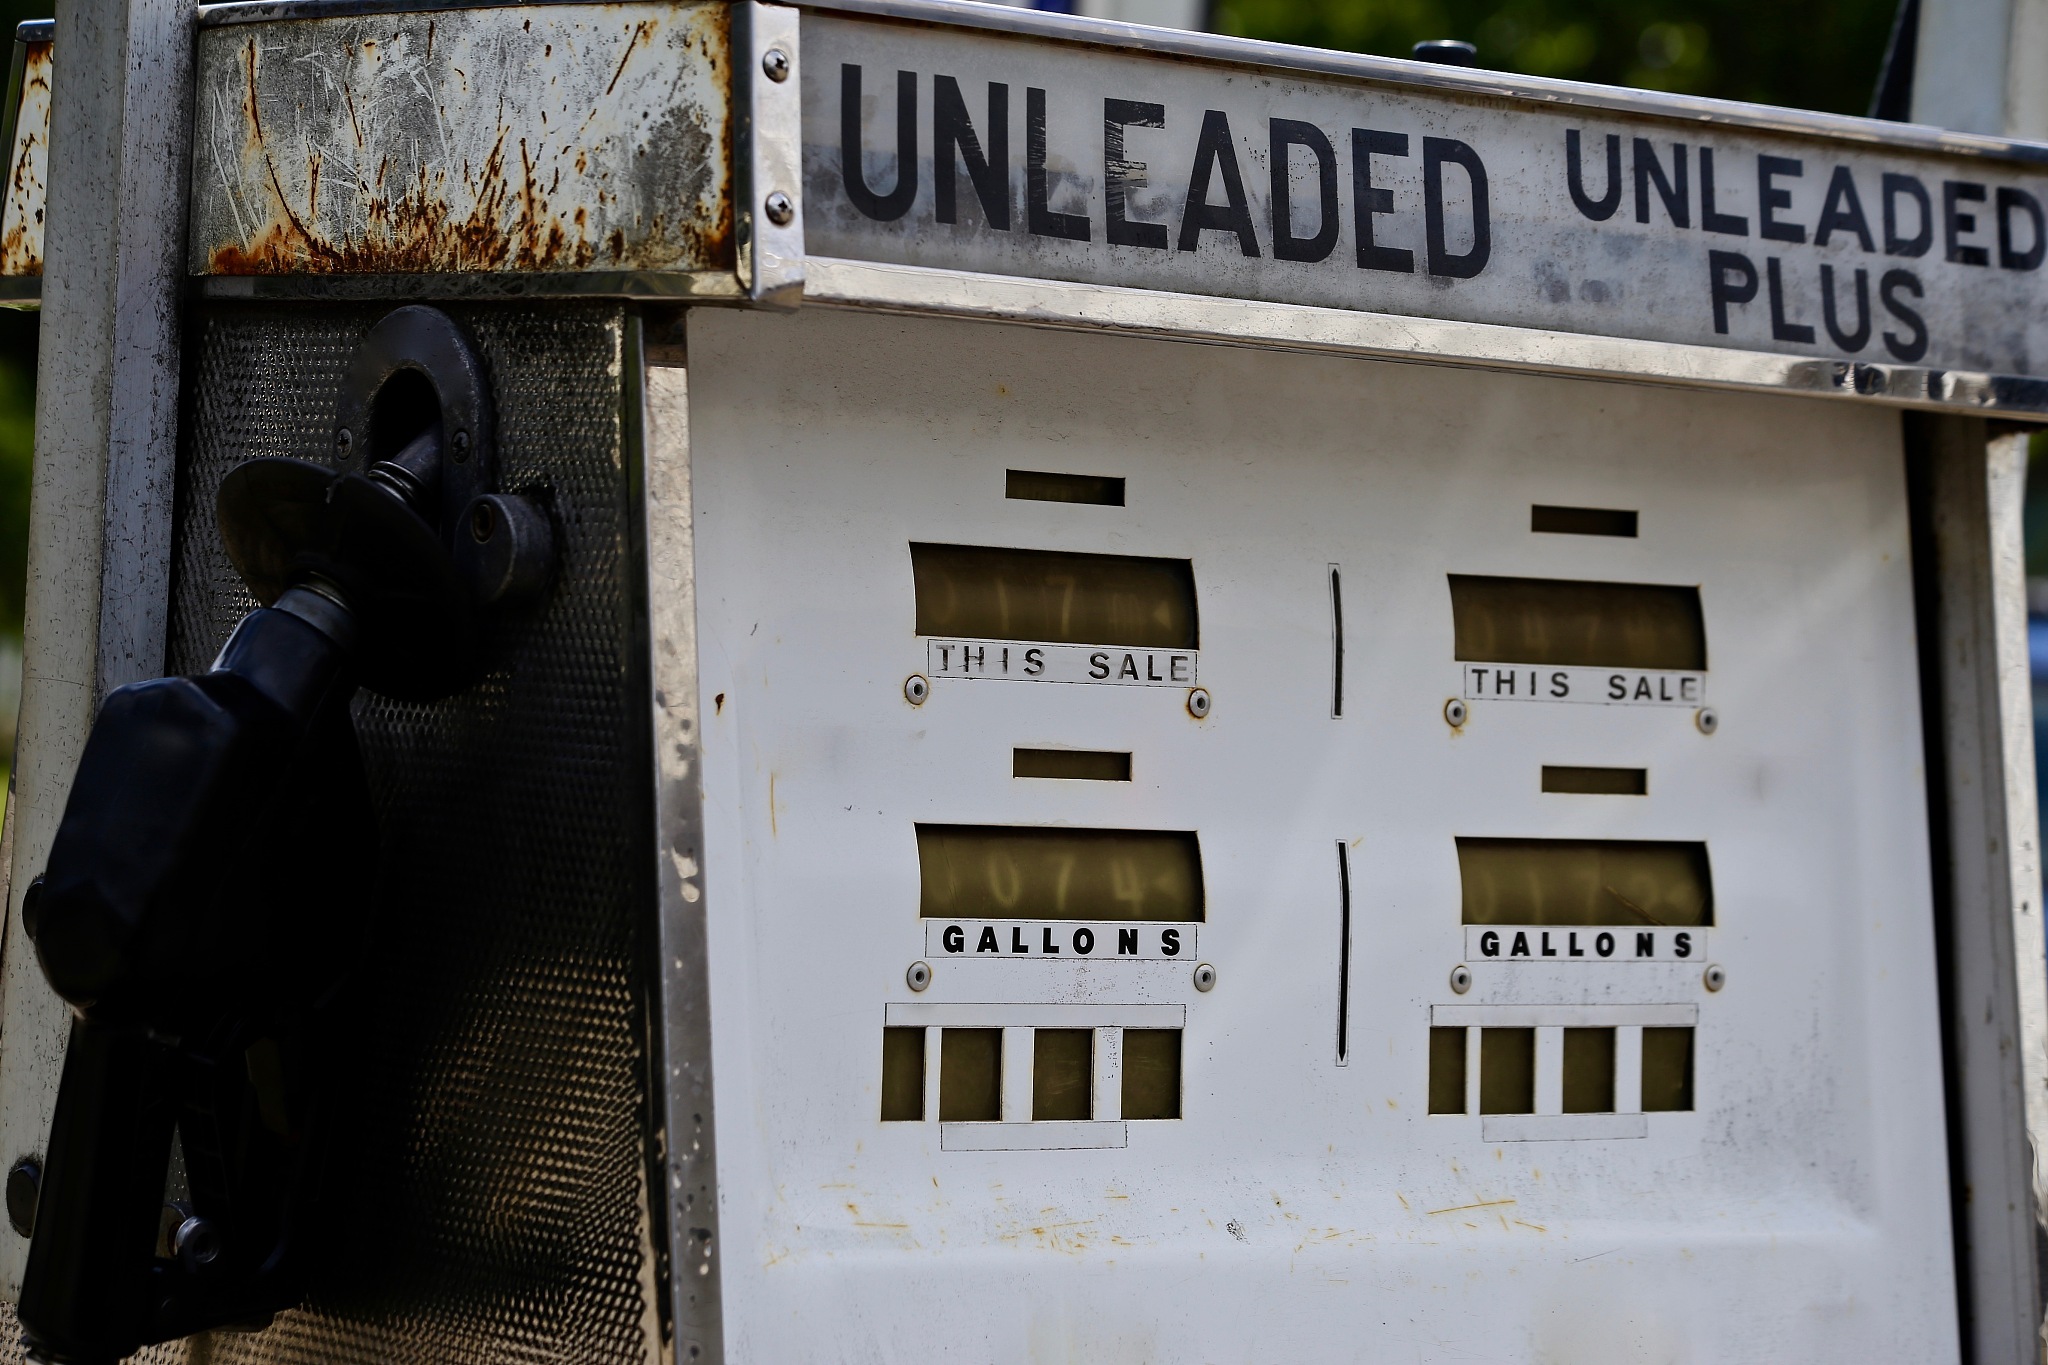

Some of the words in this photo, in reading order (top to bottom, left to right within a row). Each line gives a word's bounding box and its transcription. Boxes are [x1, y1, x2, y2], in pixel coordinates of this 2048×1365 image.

[840, 63, 1490, 279] UNLEADED
[1565, 128, 2047, 272] UNLEADED
[1707, 249, 1930, 363] PLUS
[935, 644, 1046, 677] THIS
[1087, 651, 1190, 682] SALE
[1471, 668, 1571, 698] THIS
[1607, 674, 1699, 702] SALE
[942, 925, 1181, 957] GALLONS
[1480, 931, 1692, 958] GALLONS
